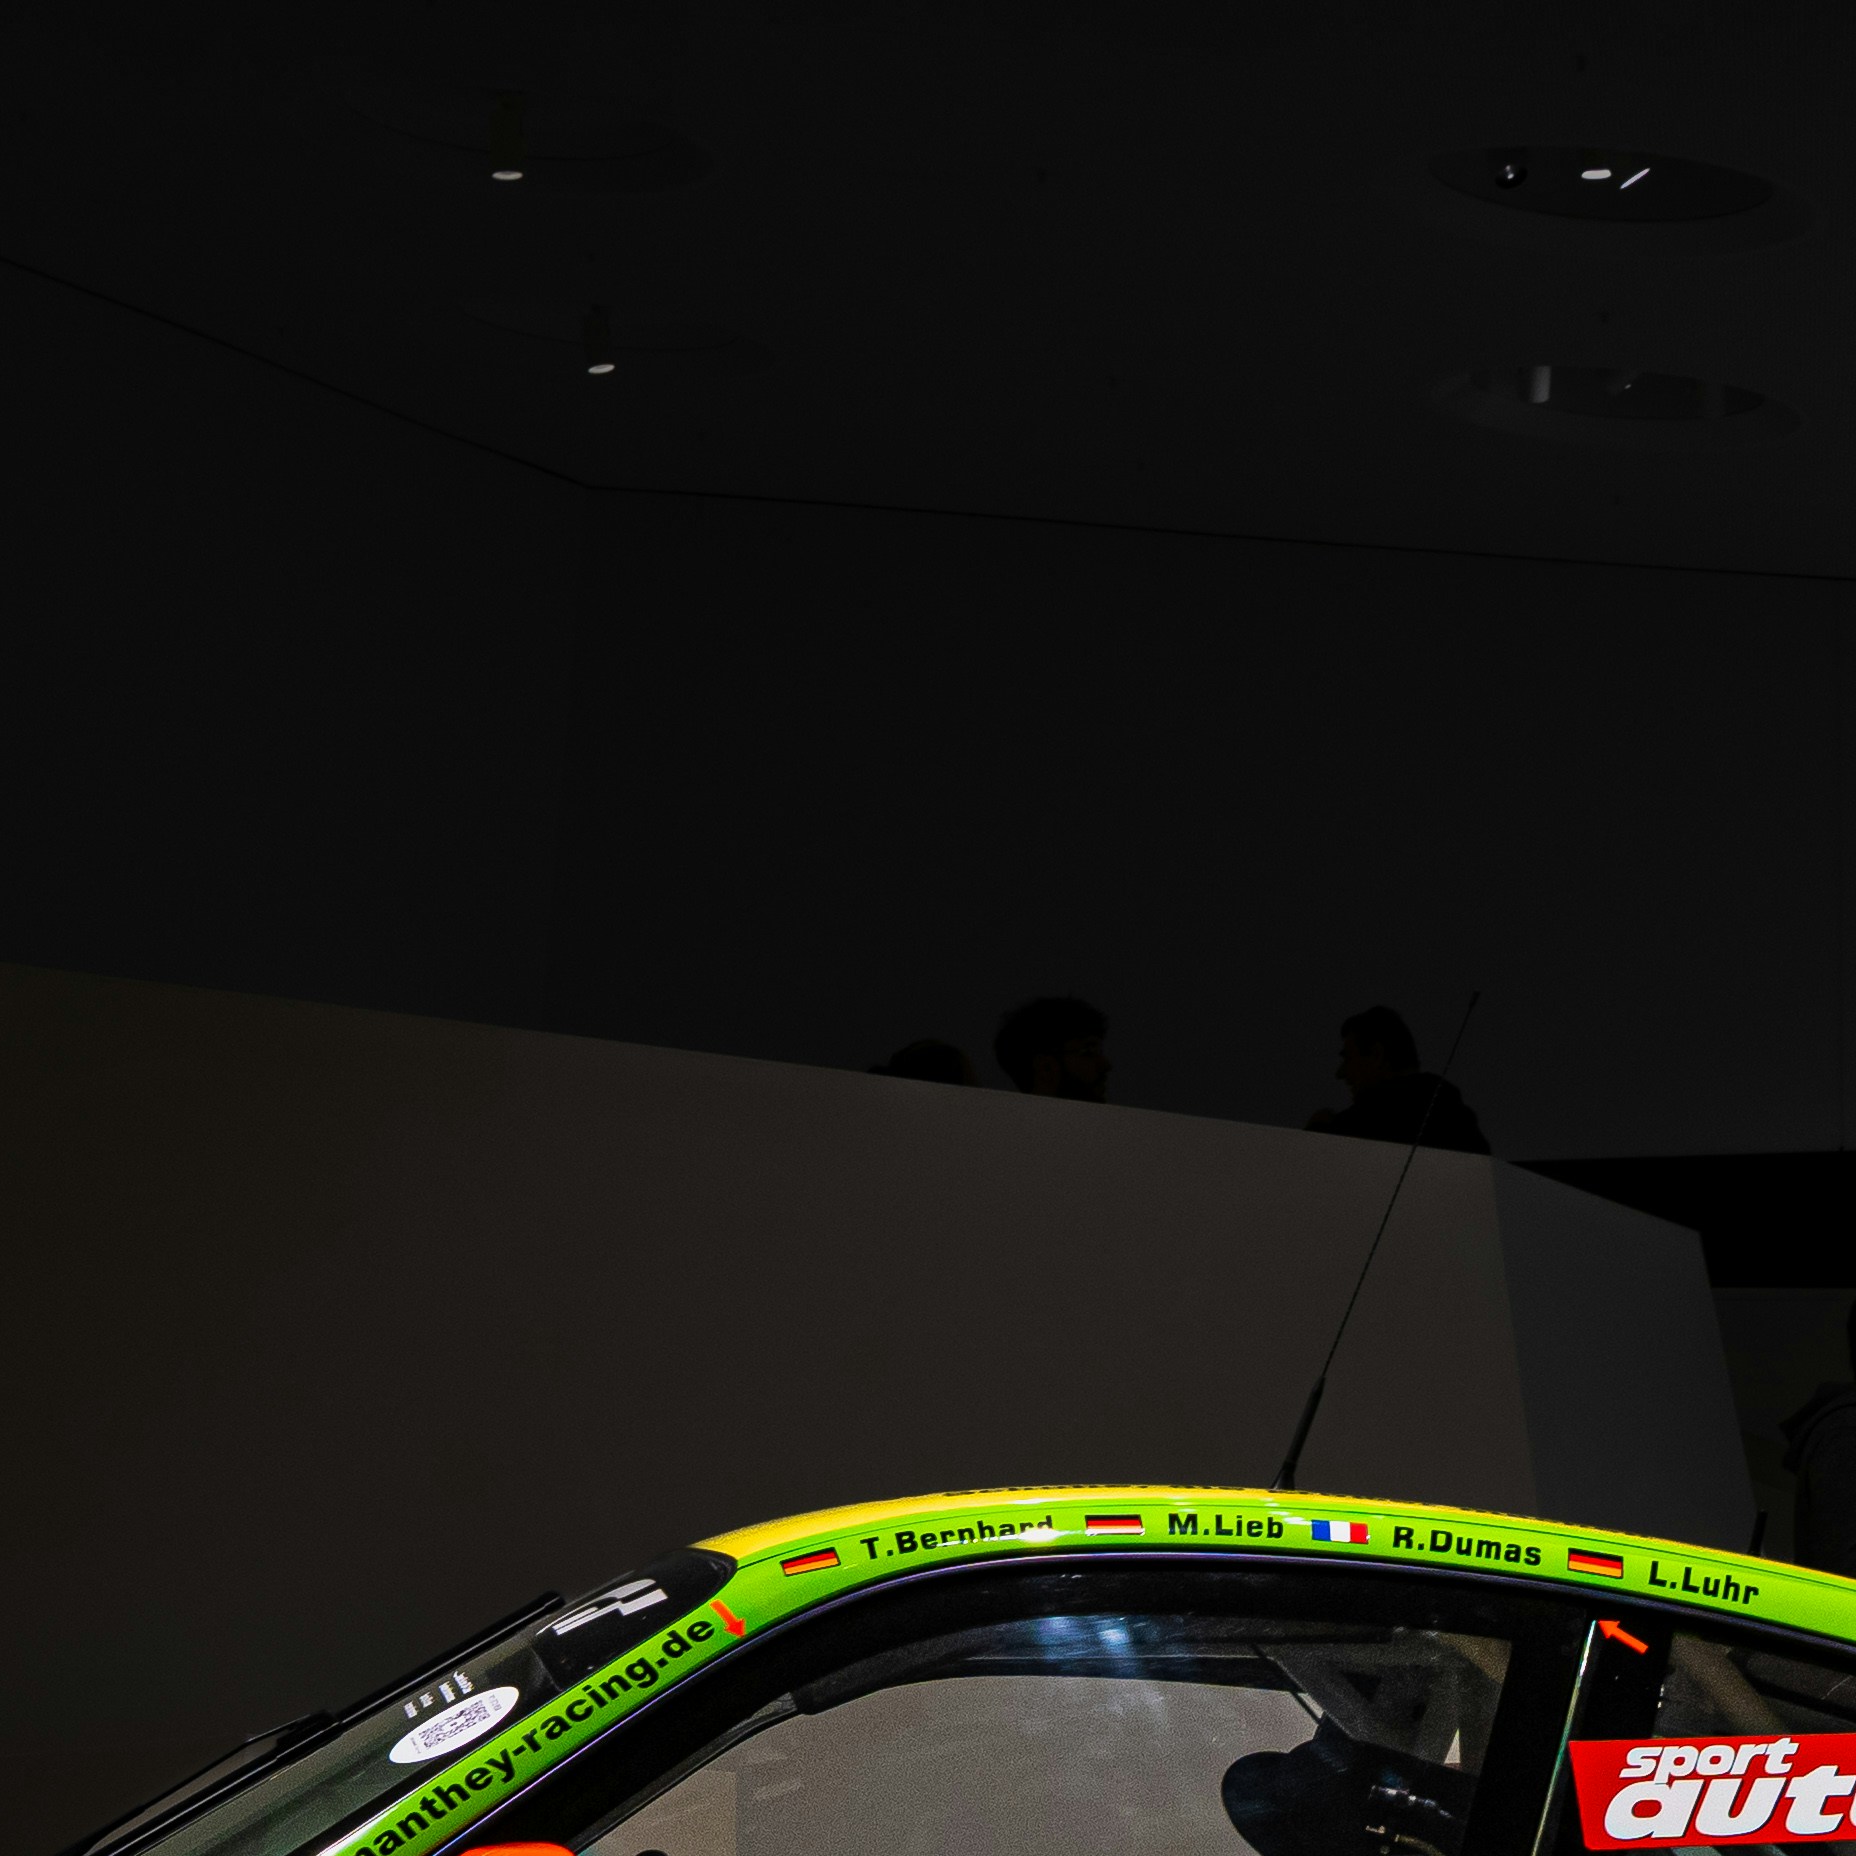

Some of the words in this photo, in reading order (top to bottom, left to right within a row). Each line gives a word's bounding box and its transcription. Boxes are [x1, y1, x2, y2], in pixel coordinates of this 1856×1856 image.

[860, 1515, 1054, 1561] T.Bernhard
[1168, 1513, 1285, 1540] M.Lieb
[1393, 1526, 1543, 1567] R.Dumas
[1647, 1560, 1761, 1605] L.Luhr
[1619, 1738, 1799, 1785] sport
